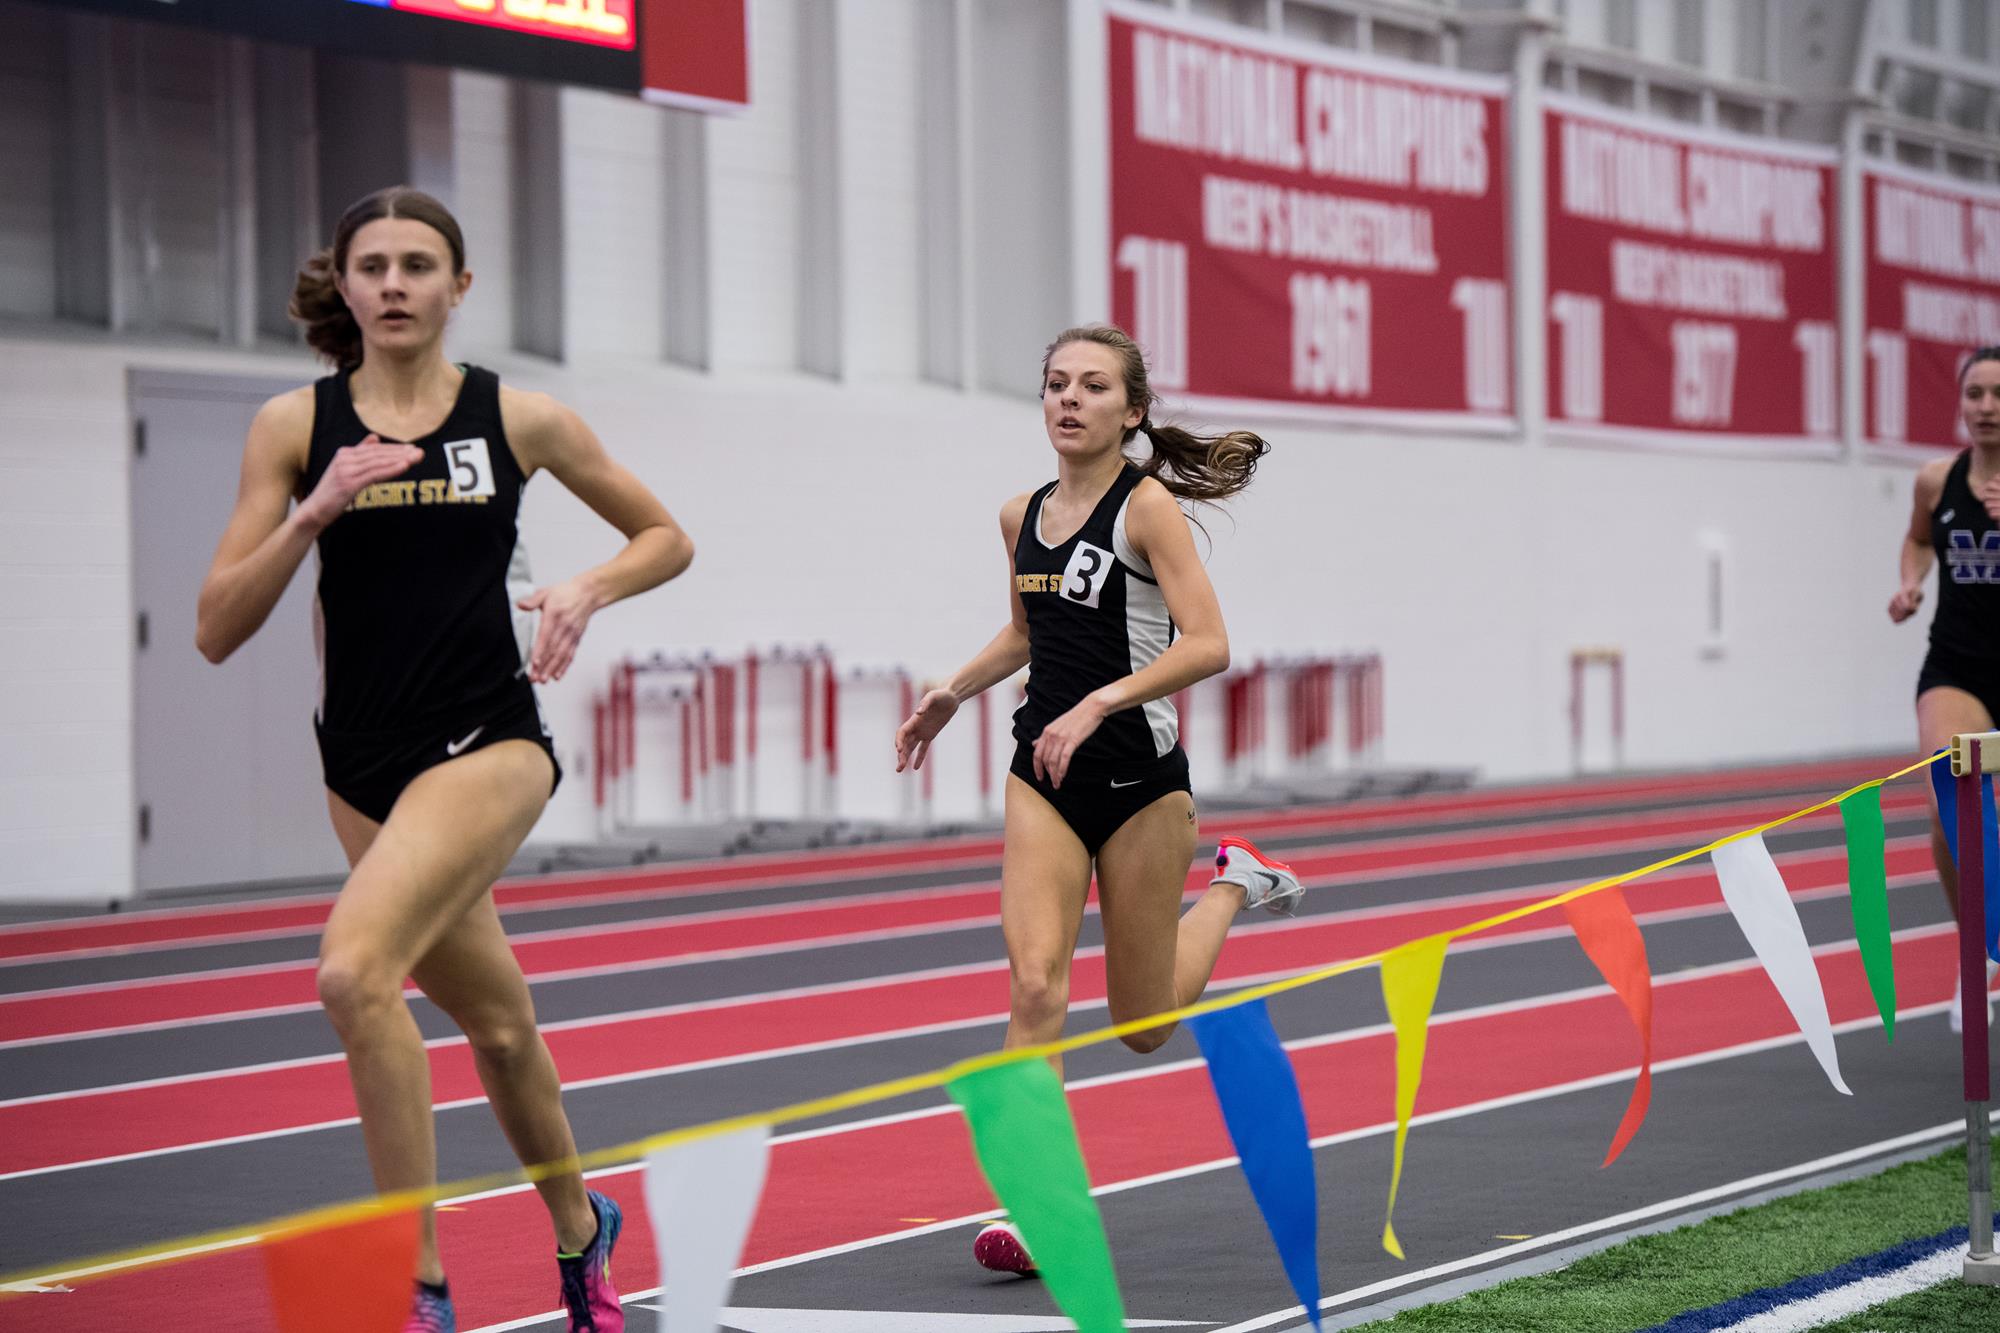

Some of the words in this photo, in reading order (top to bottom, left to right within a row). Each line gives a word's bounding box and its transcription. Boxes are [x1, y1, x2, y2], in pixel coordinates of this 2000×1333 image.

[1290, 275, 1370, 394] 1961
[1672, 324, 1736, 424] 1977
[451, 445, 478, 491] 5
[1015, 574, 1048, 592] RIGHT
[1068, 549, 1101, 601] 3
